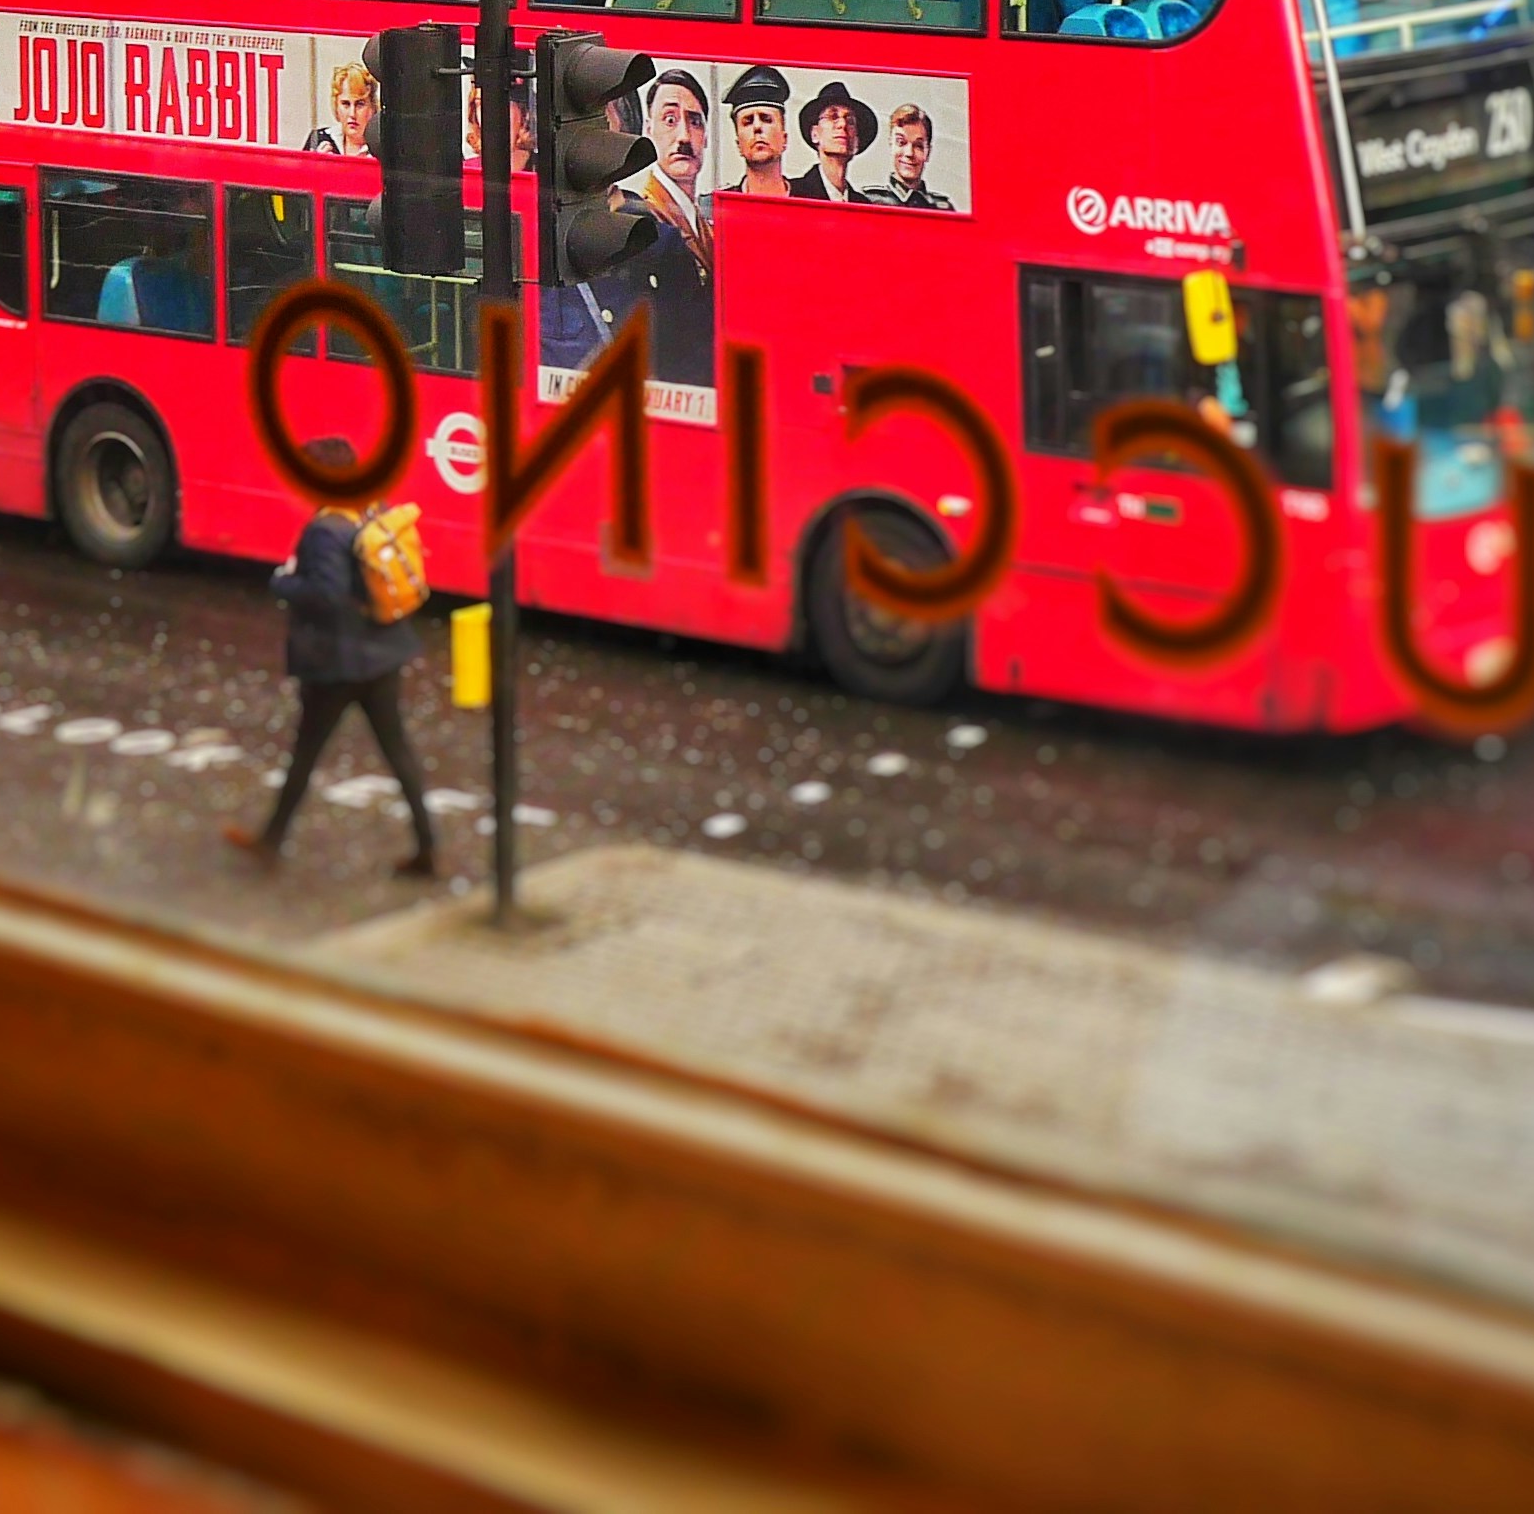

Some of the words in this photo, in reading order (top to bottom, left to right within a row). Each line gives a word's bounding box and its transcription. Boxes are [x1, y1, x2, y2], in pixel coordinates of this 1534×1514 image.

[41, 21, 53, 33] THE
[14, 35, 106, 128] JOJO
[126, 45, 284, 145] RABBIT
[1109, 195, 1233, 239] ARRIVA
[548, 373, 563, 396] IN
